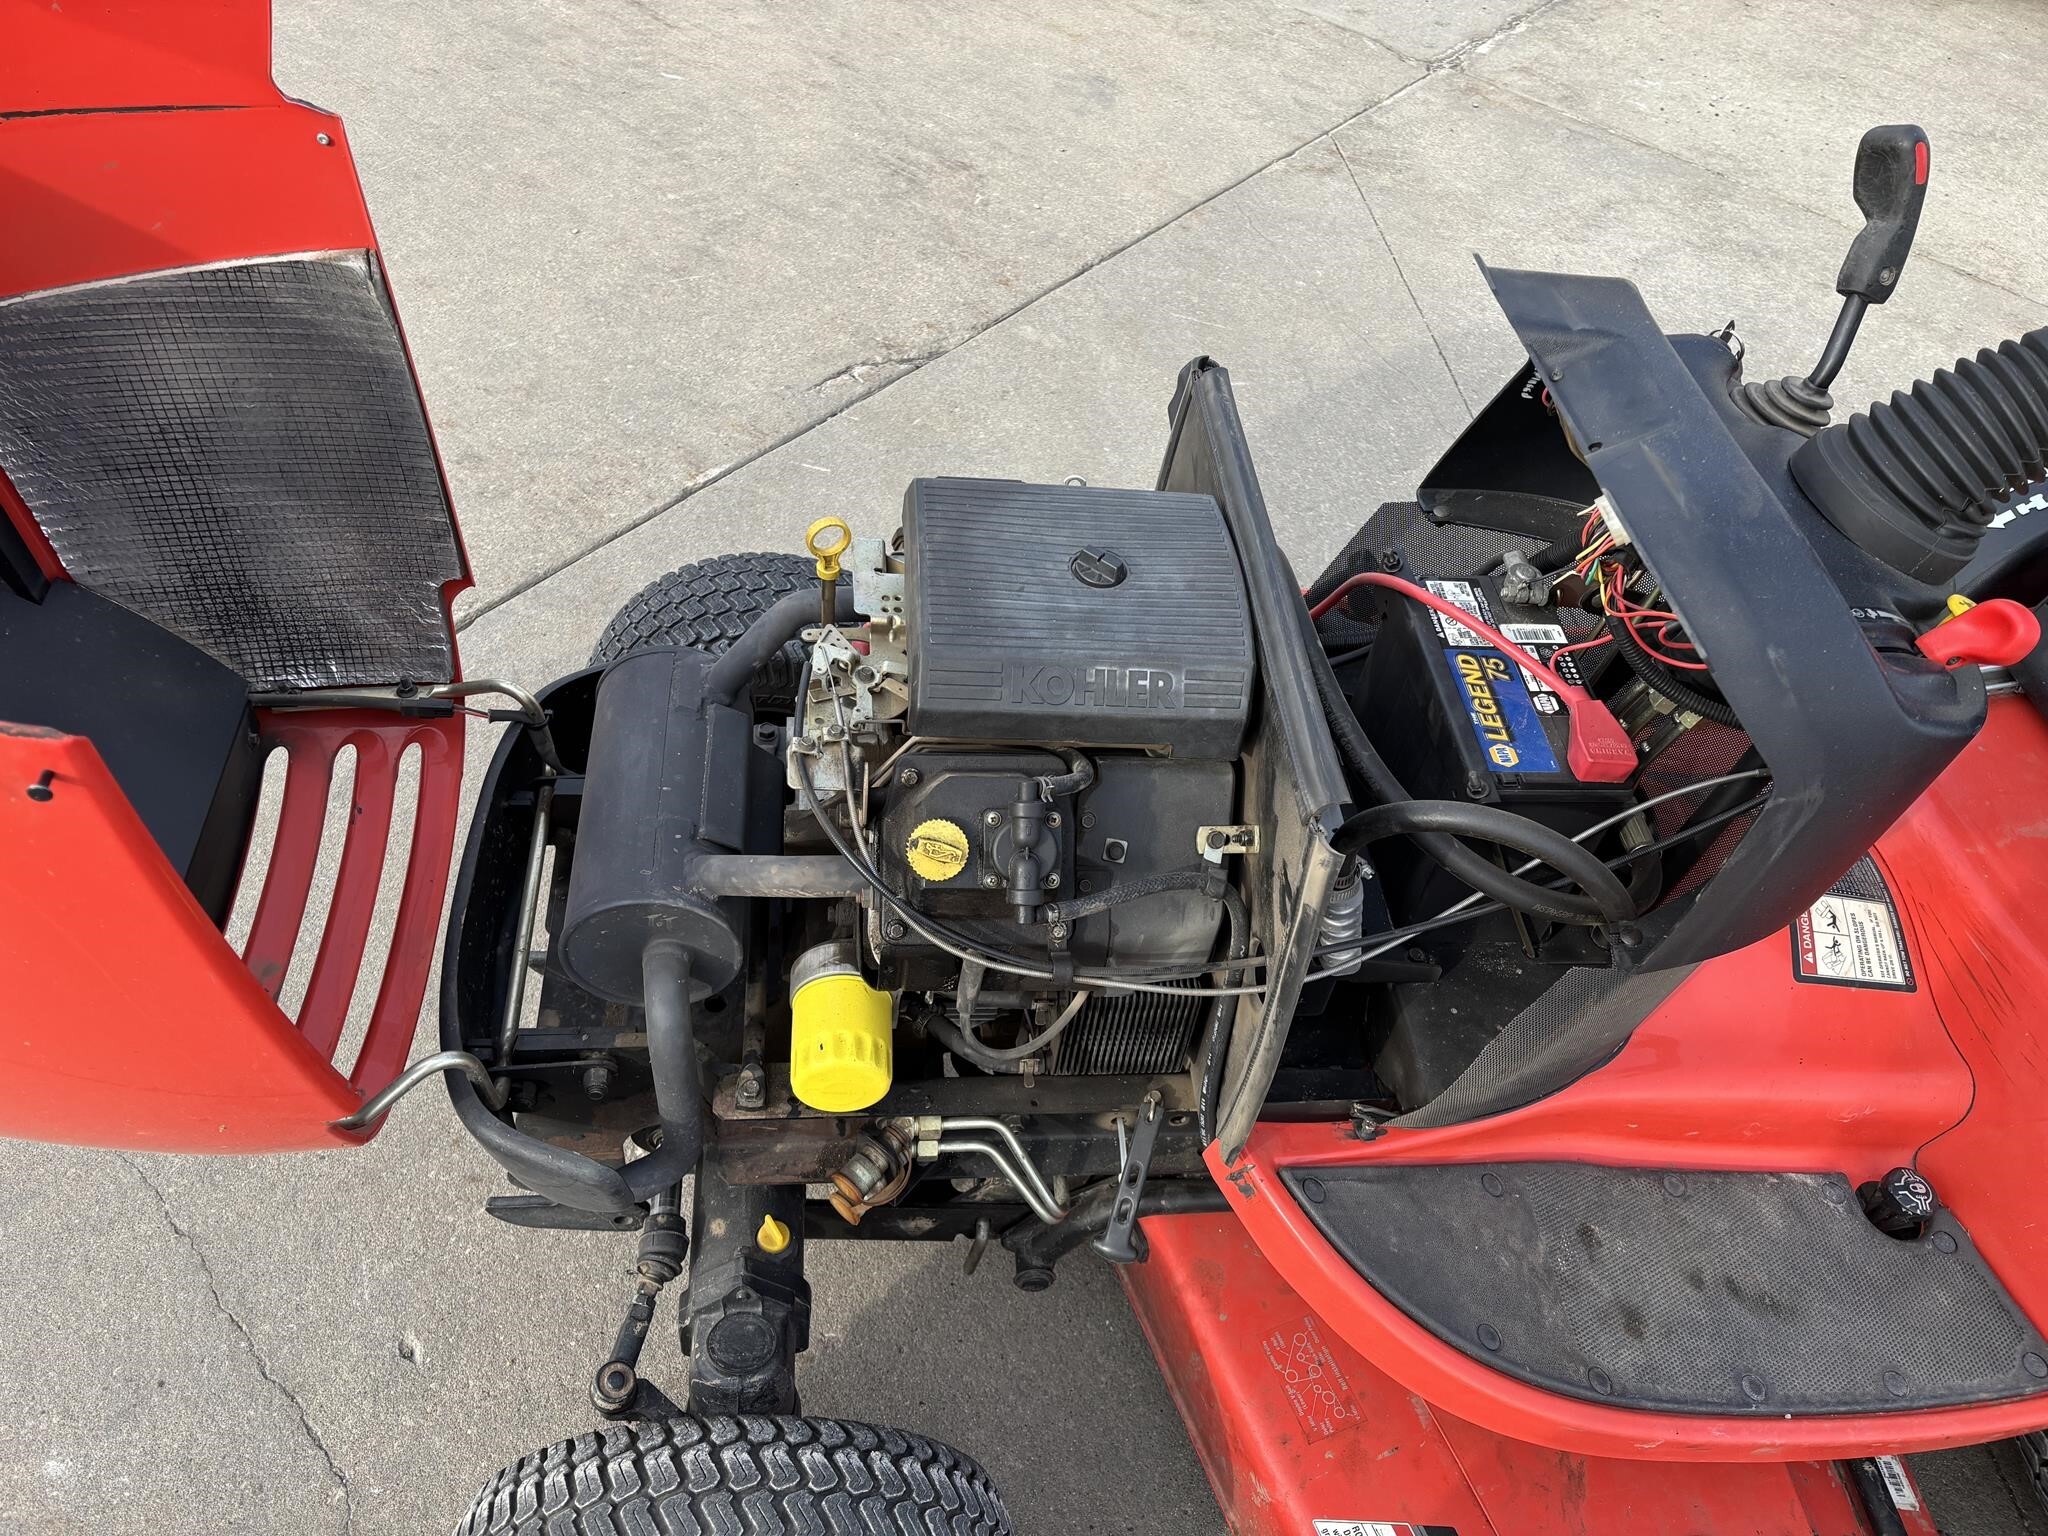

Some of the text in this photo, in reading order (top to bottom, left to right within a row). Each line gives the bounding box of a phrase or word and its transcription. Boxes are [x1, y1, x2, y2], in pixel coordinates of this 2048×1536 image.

[1483, 656, 1513, 681] 75
[1011, 664, 1176, 709] KOHLER
[1457, 654, 1511, 742] LEGEND
[1537, 694, 1556, 713] NAPA
[1494, 747, 1513, 764] NAPA
[1801, 911, 1812, 949] DANGE
[1850, 912, 1867, 977] OPERATING ON SLOPES
[1858, 921, 1870, 955] DANGEROUS
[1865, 956, 1871, 964] BE
